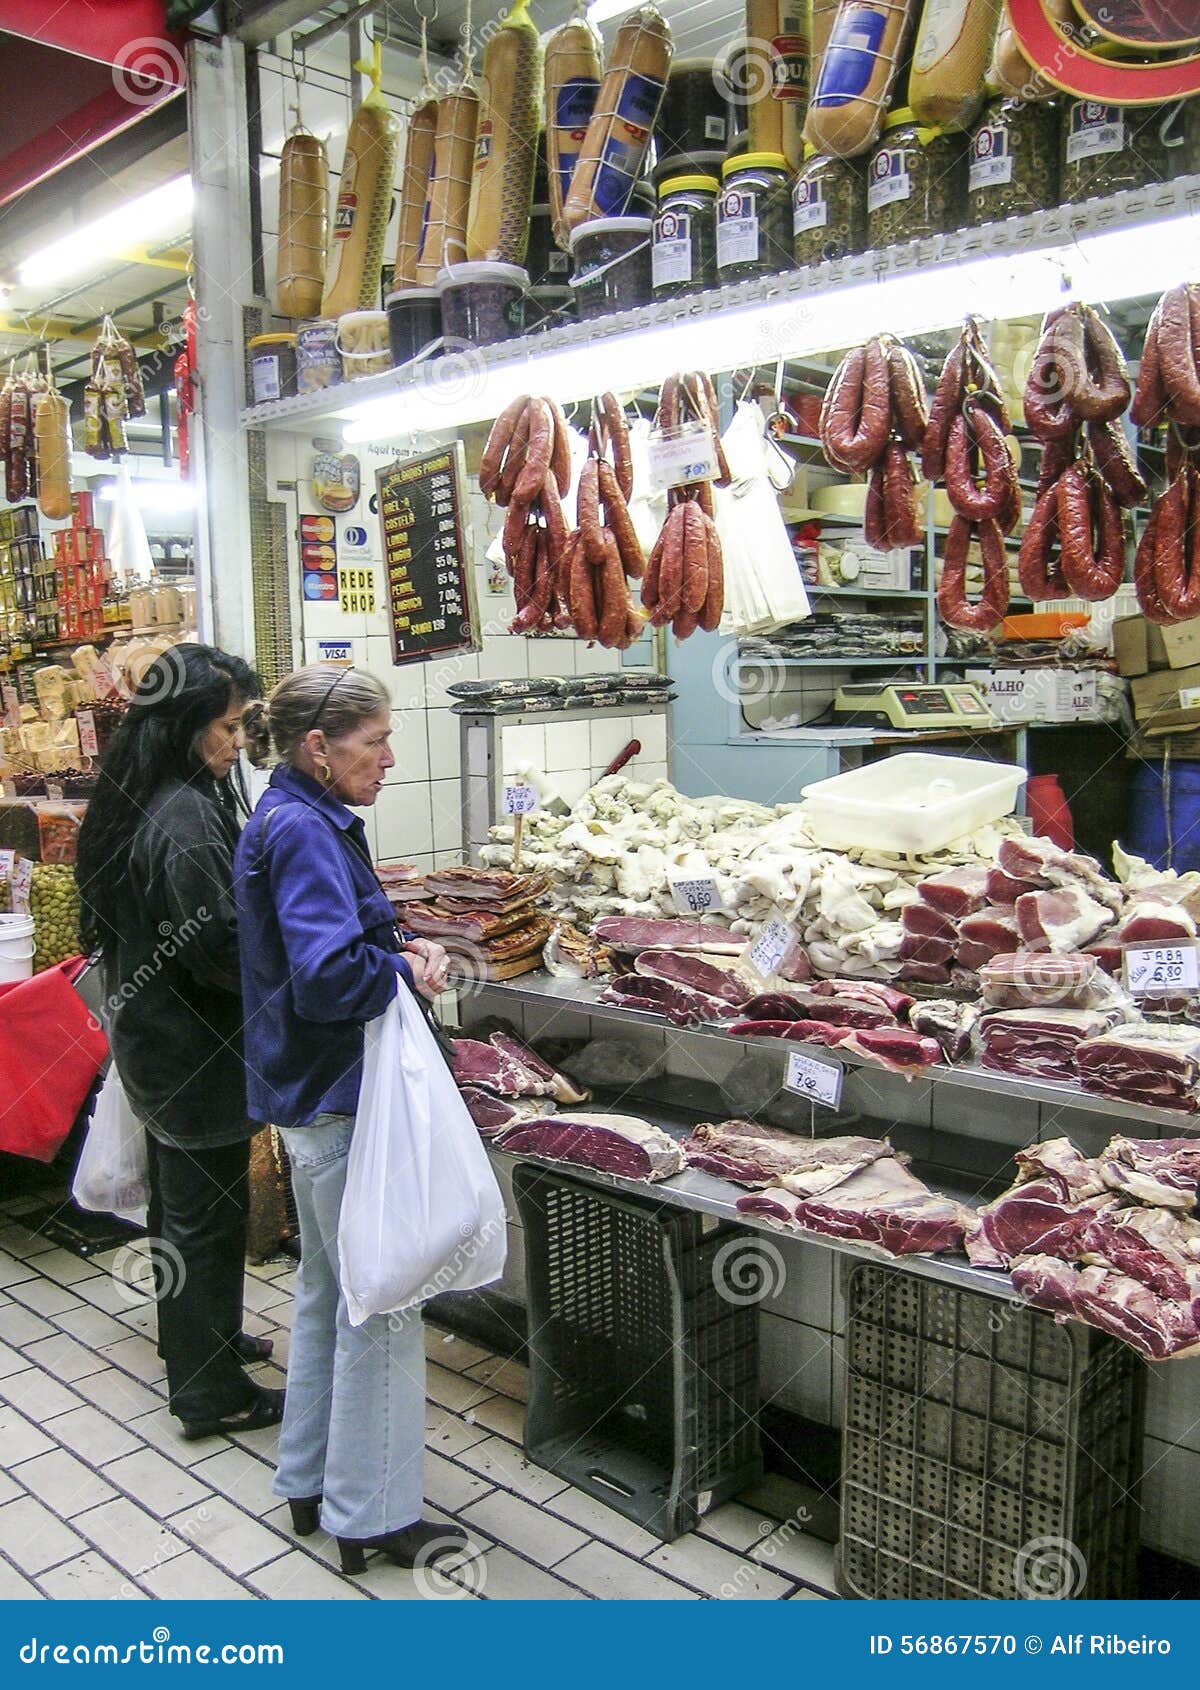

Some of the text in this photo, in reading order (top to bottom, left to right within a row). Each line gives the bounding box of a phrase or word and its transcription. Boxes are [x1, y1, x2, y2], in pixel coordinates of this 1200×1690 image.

[340, 571, 374, 589] REDE
[341, 595, 375, 612] SHOP
[324, 649, 347, 659] VISA
[989, 681, 1025, 692] ALHO
[1141, 950, 1182, 961] JABA
